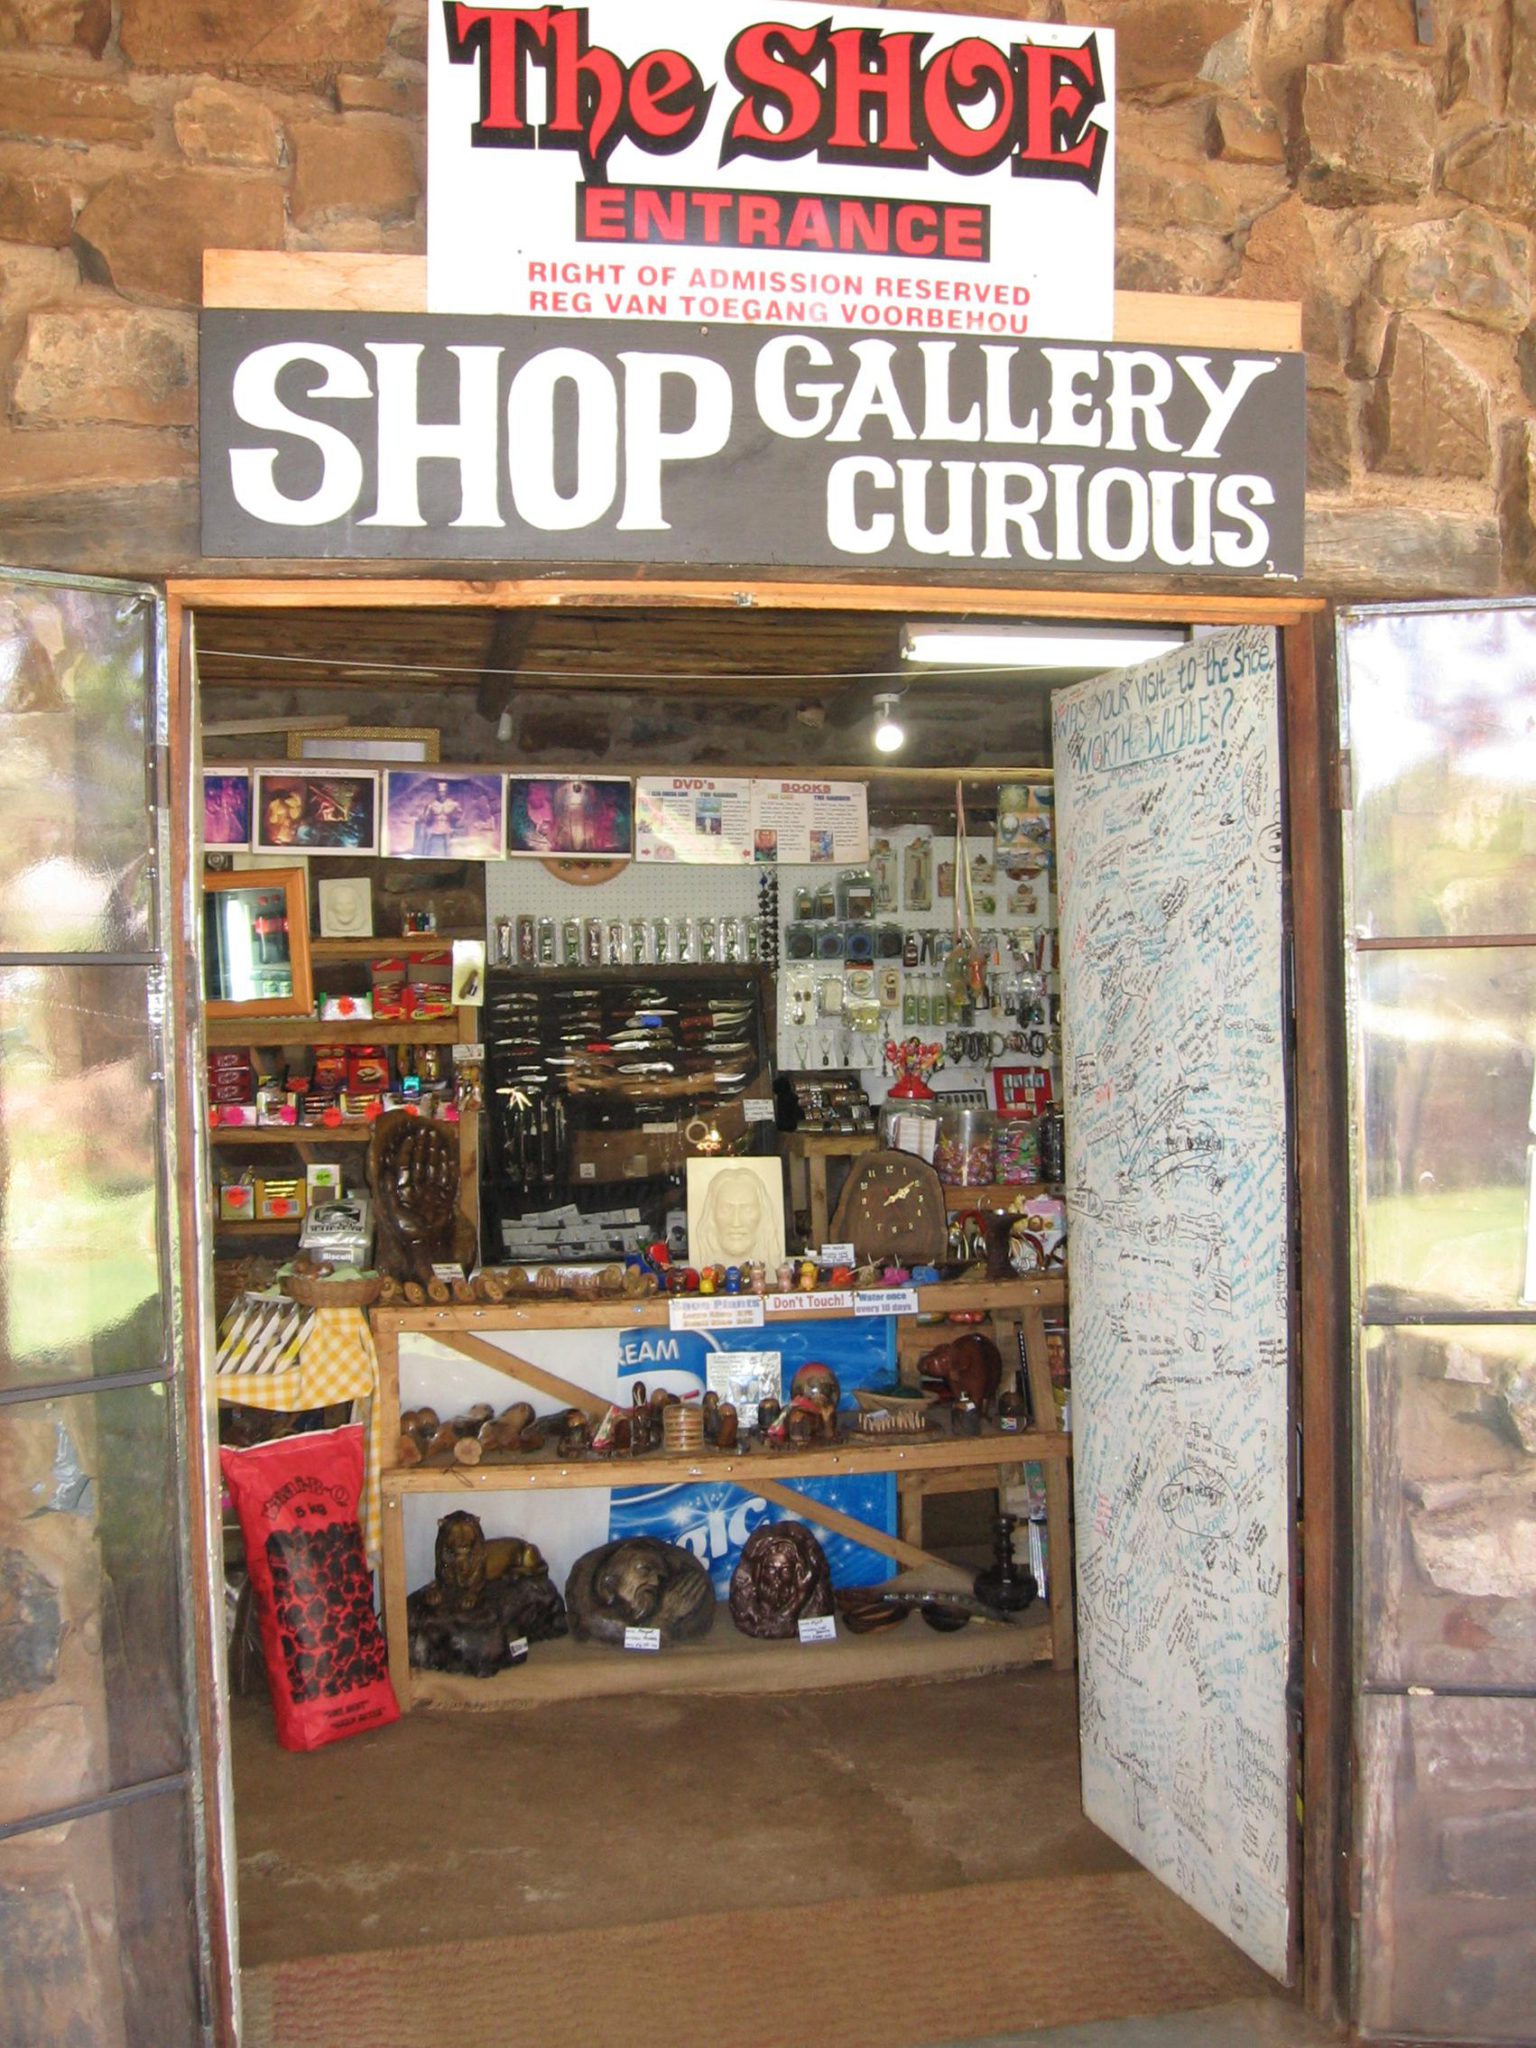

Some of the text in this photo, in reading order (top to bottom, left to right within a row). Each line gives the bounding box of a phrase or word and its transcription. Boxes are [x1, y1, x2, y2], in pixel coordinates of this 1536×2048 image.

[443, 1, 1108, 196] The SHOE
[584, 187, 984, 259] ENTRANCE
[528, 262, 1031, 307] RIGHT OF ADMISSION RESERVED
[529, 291, 1029, 335] REG VAN TOEGANG VOORBEHOU
[754, 334, 1282, 459] GALLERY
[230, 342, 734, 532] SHOP
[826, 456, 1277, 569] CURIOUS
[1054, 699, 1088, 741] WAS
[1097, 688, 1130, 723] YOUR
[1206, 649, 1229, 687] the
[1077, 722, 1133, 774] WORTH
[1145, 696, 1210, 754] WHILE
[672, 779, 716, 791] DVD's
[781, 783, 832, 794] BOOKS
[773, 1294, 845, 1309] Don't Touch!
